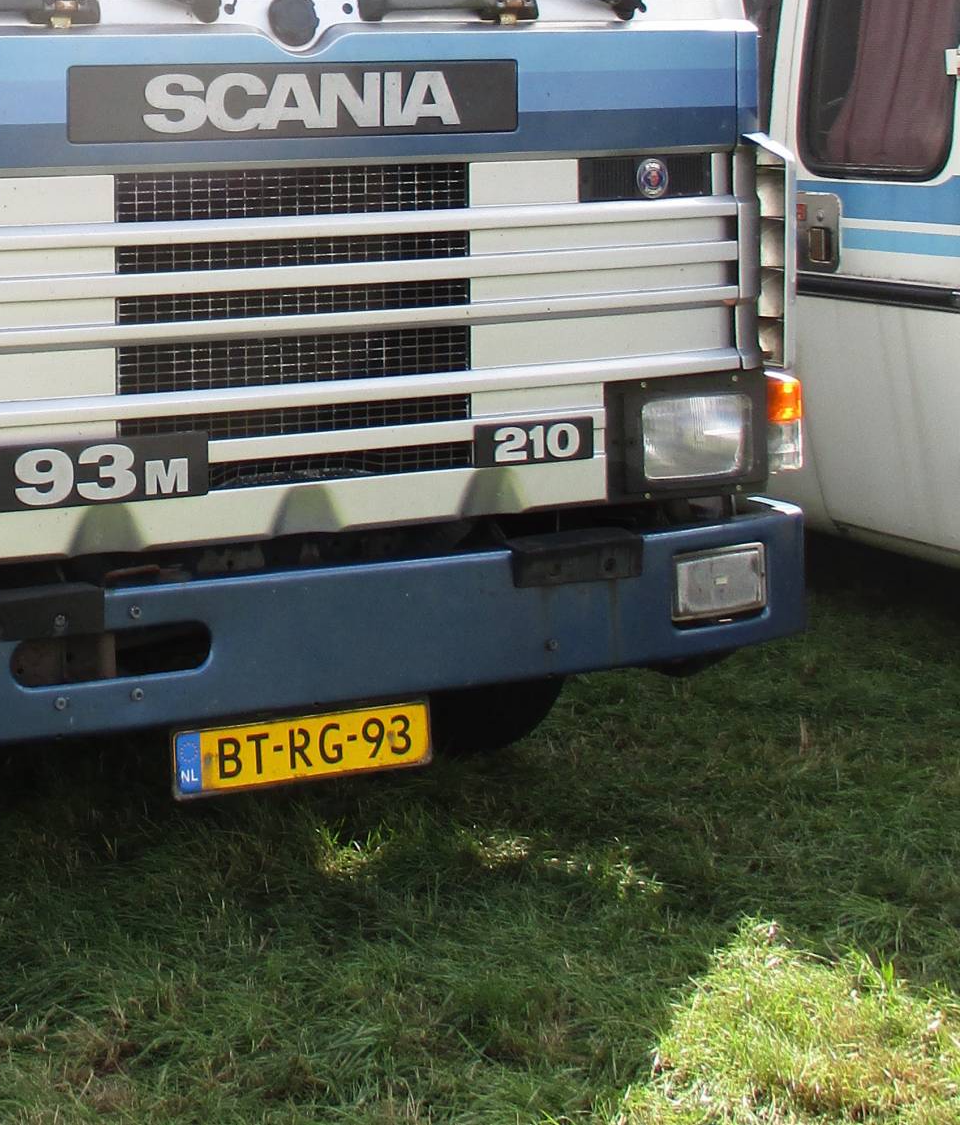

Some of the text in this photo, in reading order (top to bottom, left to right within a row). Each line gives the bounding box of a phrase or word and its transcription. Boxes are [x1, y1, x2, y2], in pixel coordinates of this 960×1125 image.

[143, 70, 461, 134] SCANIA
[493, 422, 581, 463] 210
[217, 714, 412, 780] BT-RG-93
[180, 769, 199, 783] NL
